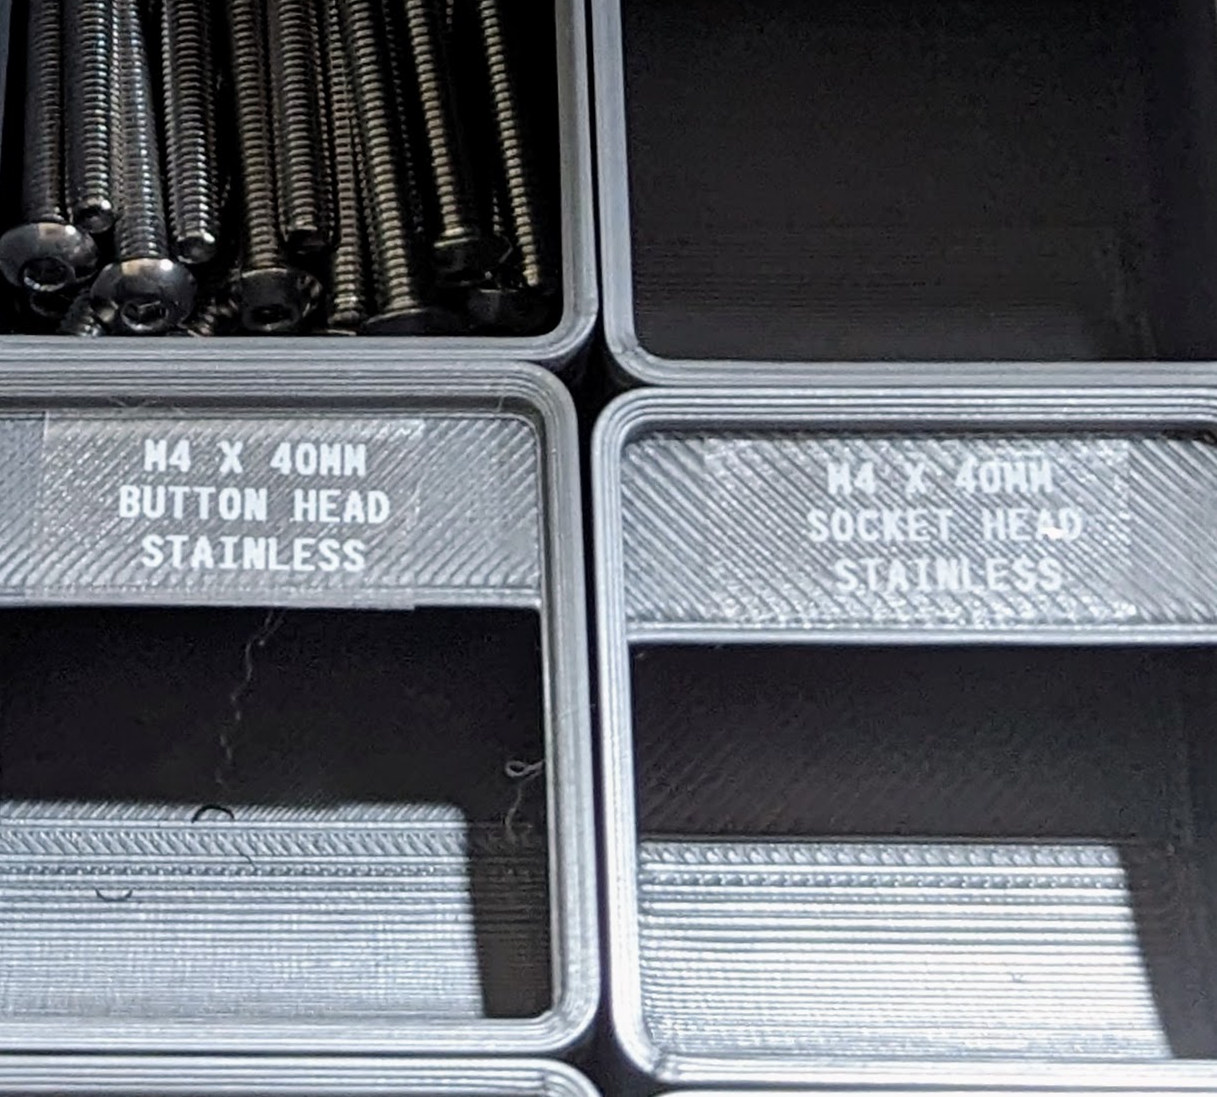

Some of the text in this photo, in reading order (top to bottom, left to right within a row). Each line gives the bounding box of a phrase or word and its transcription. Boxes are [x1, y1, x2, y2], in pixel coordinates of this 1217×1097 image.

[144, 439, 367, 477] M4 X 40MM
[828, 457, 1053, 495] M4 X 40MM
[119, 485, 390, 524] BUTTON HEAD
[806, 507, 1082, 542] SOCKET HEAD
[141, 534, 366, 572] STAINLESS
[835, 557, 1062, 592] STAINLESS
